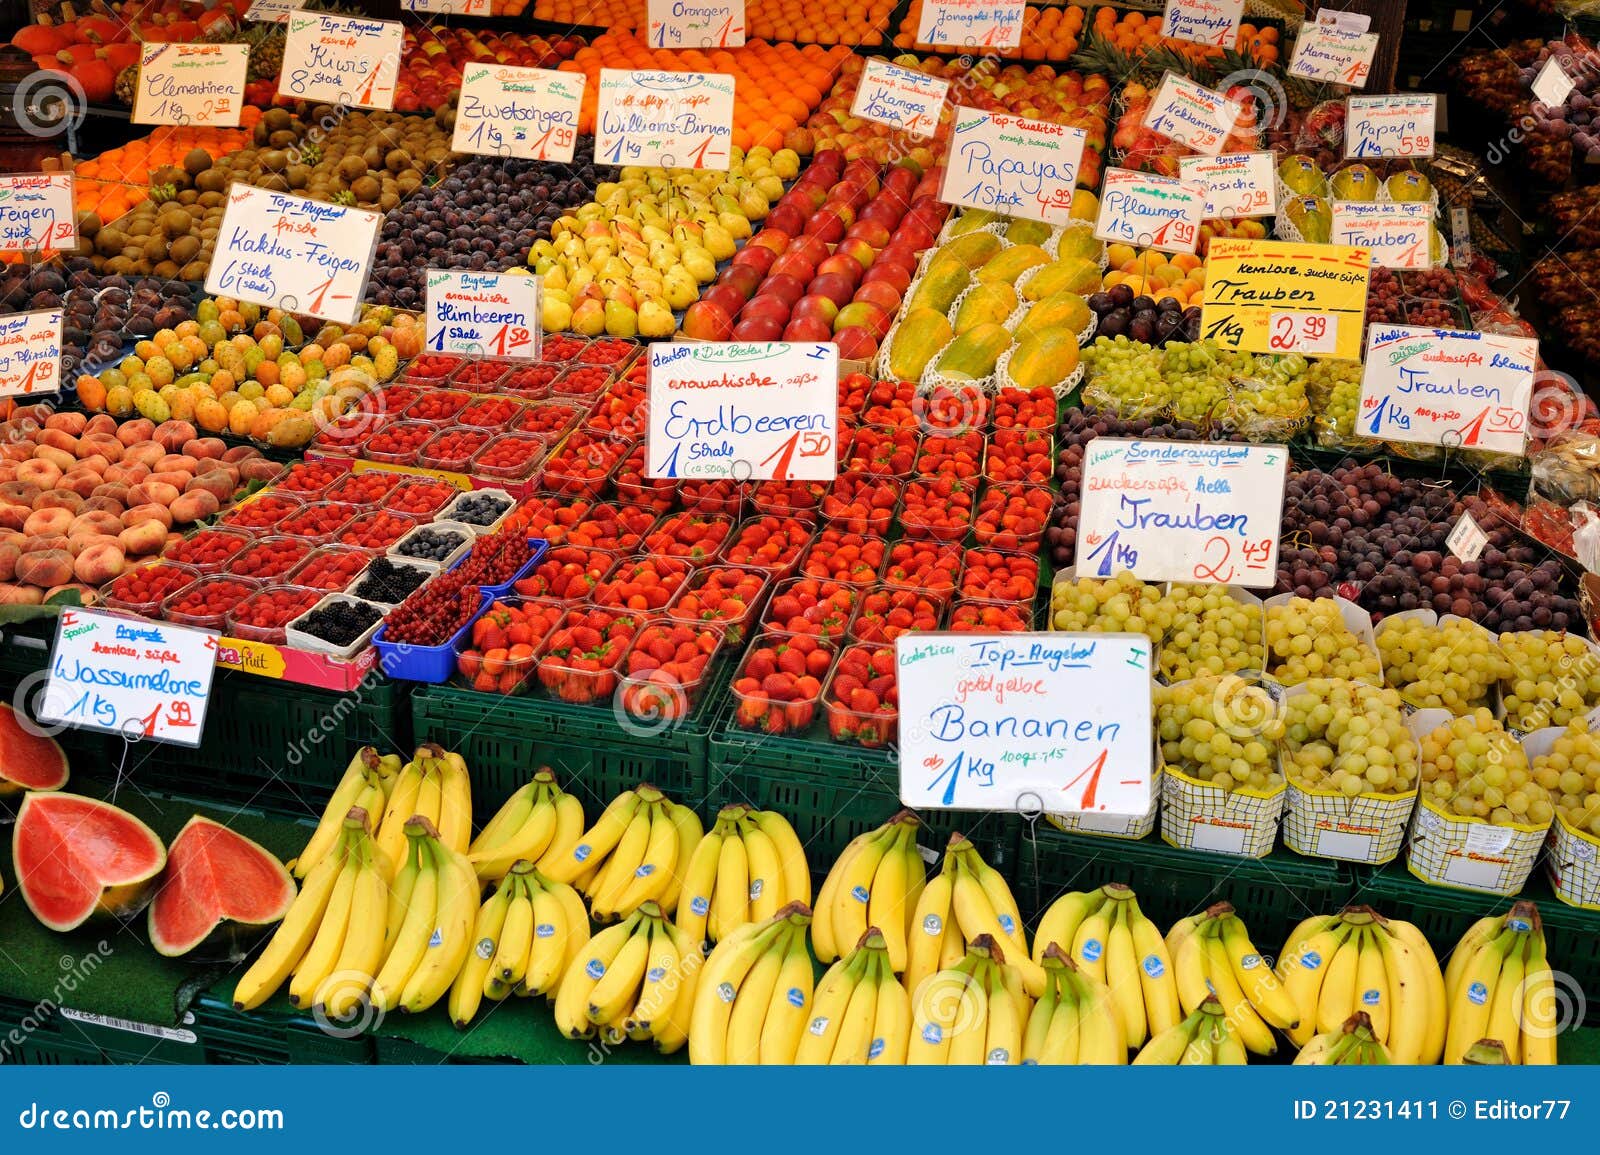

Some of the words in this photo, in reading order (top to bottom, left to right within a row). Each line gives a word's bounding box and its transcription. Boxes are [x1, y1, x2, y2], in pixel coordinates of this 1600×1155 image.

[304, 43, 368, 74] Kiwis
[146, 73, 241, 97] Clementinen
[290, 69, 309, 94] 8
[463, 96, 578, 133] Zwetschgen
[602, 110, 731, 137] Williams-Birnen
[1355, 120, 1416, 140] Papaja
[960, 141, 1074, 194] Papayas
[229, 226, 360, 279] Kaktus-Feigen
[1341, 231, 1417, 247] Trauben
[1212, 280, 1316, 301] Trauben
[437, 301, 527, 327] Himbeeren
[428, 326, 446, 351] 1
[1396, 367, 1500, 403] Trauben
[665, 400, 832, 440] Erdbeeren
[1364, 395, 1391, 434] 1
[657, 442, 681, 477] 1
[1116, 494, 1248, 536] Trauben
[1087, 530, 1120, 576] 1
[54, 654, 207, 697] Wassermelone
[955, 673, 1048, 704] goldgelbe
[64, 691, 90, 716] 1
[930, 704, 1121, 742] Bananen
[927, 751, 965, 805] 1
